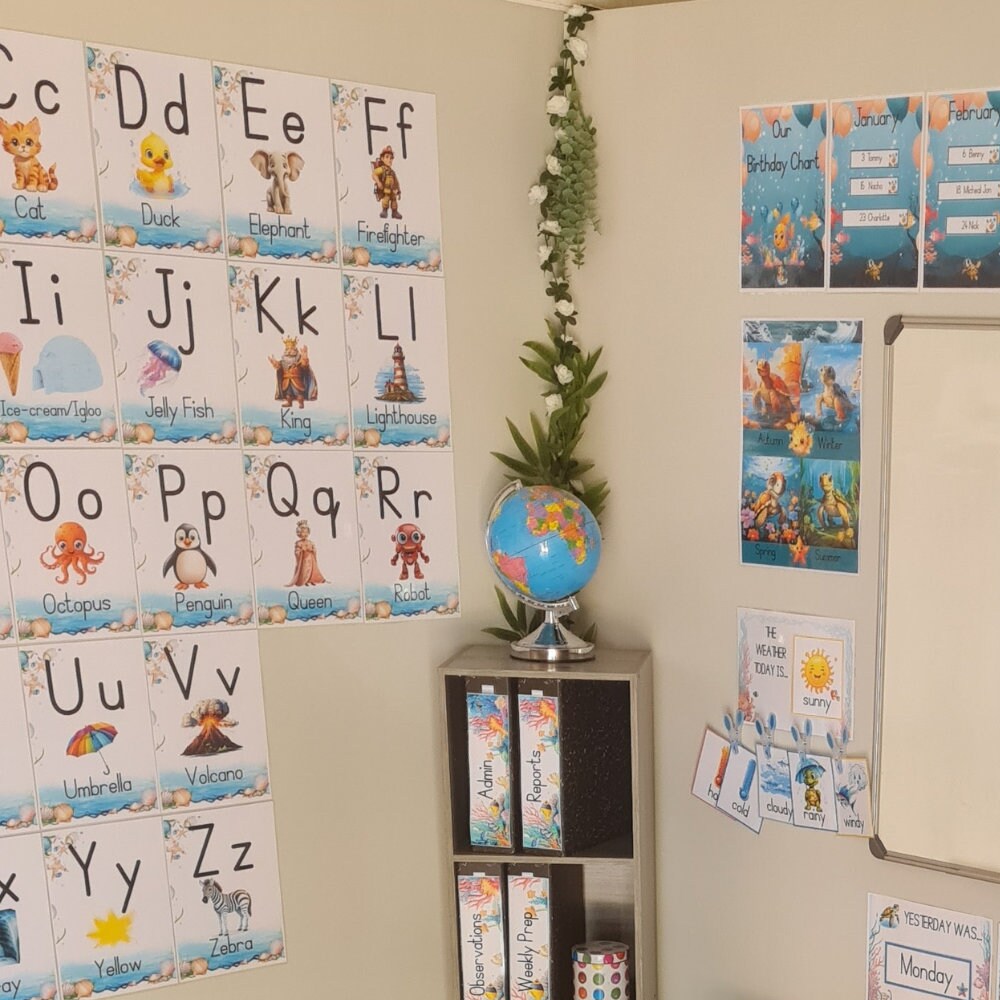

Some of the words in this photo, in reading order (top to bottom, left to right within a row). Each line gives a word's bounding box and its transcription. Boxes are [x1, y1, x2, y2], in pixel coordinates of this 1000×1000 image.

[772, 119, 792, 138] Our
[854, 107, 900, 133] January
[747, 153, 788, 179] Birthday
[790, 151, 820, 172] Chart
[14, 196, 47, 221] Cat
[141, 203, 181, 228] Duck
[249, 212, 311, 240] Elephant
[357, 221, 425, 252] Firefighter
[145, 397, 179, 426] Jelly
[183, 395, 214, 419] Fish
[281, 408, 312, 437] King
[366, 405, 437, 430] Lighthouse
[175, 592, 233, 618] Penguin
[287, 592, 333, 611] Queen
[394, 584, 430, 603] Robot
[43, 593, 112, 620] Octopus
[765, 626, 776, 639] THE
[755, 644, 786, 659] WEATHER
[754, 662, 775, 676] TODAY
[803, 696, 832, 714] sunny
[63, 776, 132, 800] Umbrella
[185, 765, 243, 787] Volcano
[477, 758, 493, 800] Admin
[526, 750, 544, 803] Reports
[732, 801, 751, 818] cold
[766, 798, 794, 824] cloudy
[803, 809, 826, 827] rainy
[844, 816, 864, 834] windy
[519, 911, 535, 944] Prep
[904, 910, 951, 937] YESTERDAY
[209, 936, 254, 957] Zebra
[469, 913, 484, 997] Observations
[94, 957, 142, 979] Yellow
[517, 945, 537, 992] Weekly
[900, 953, 954, 995] Monday
